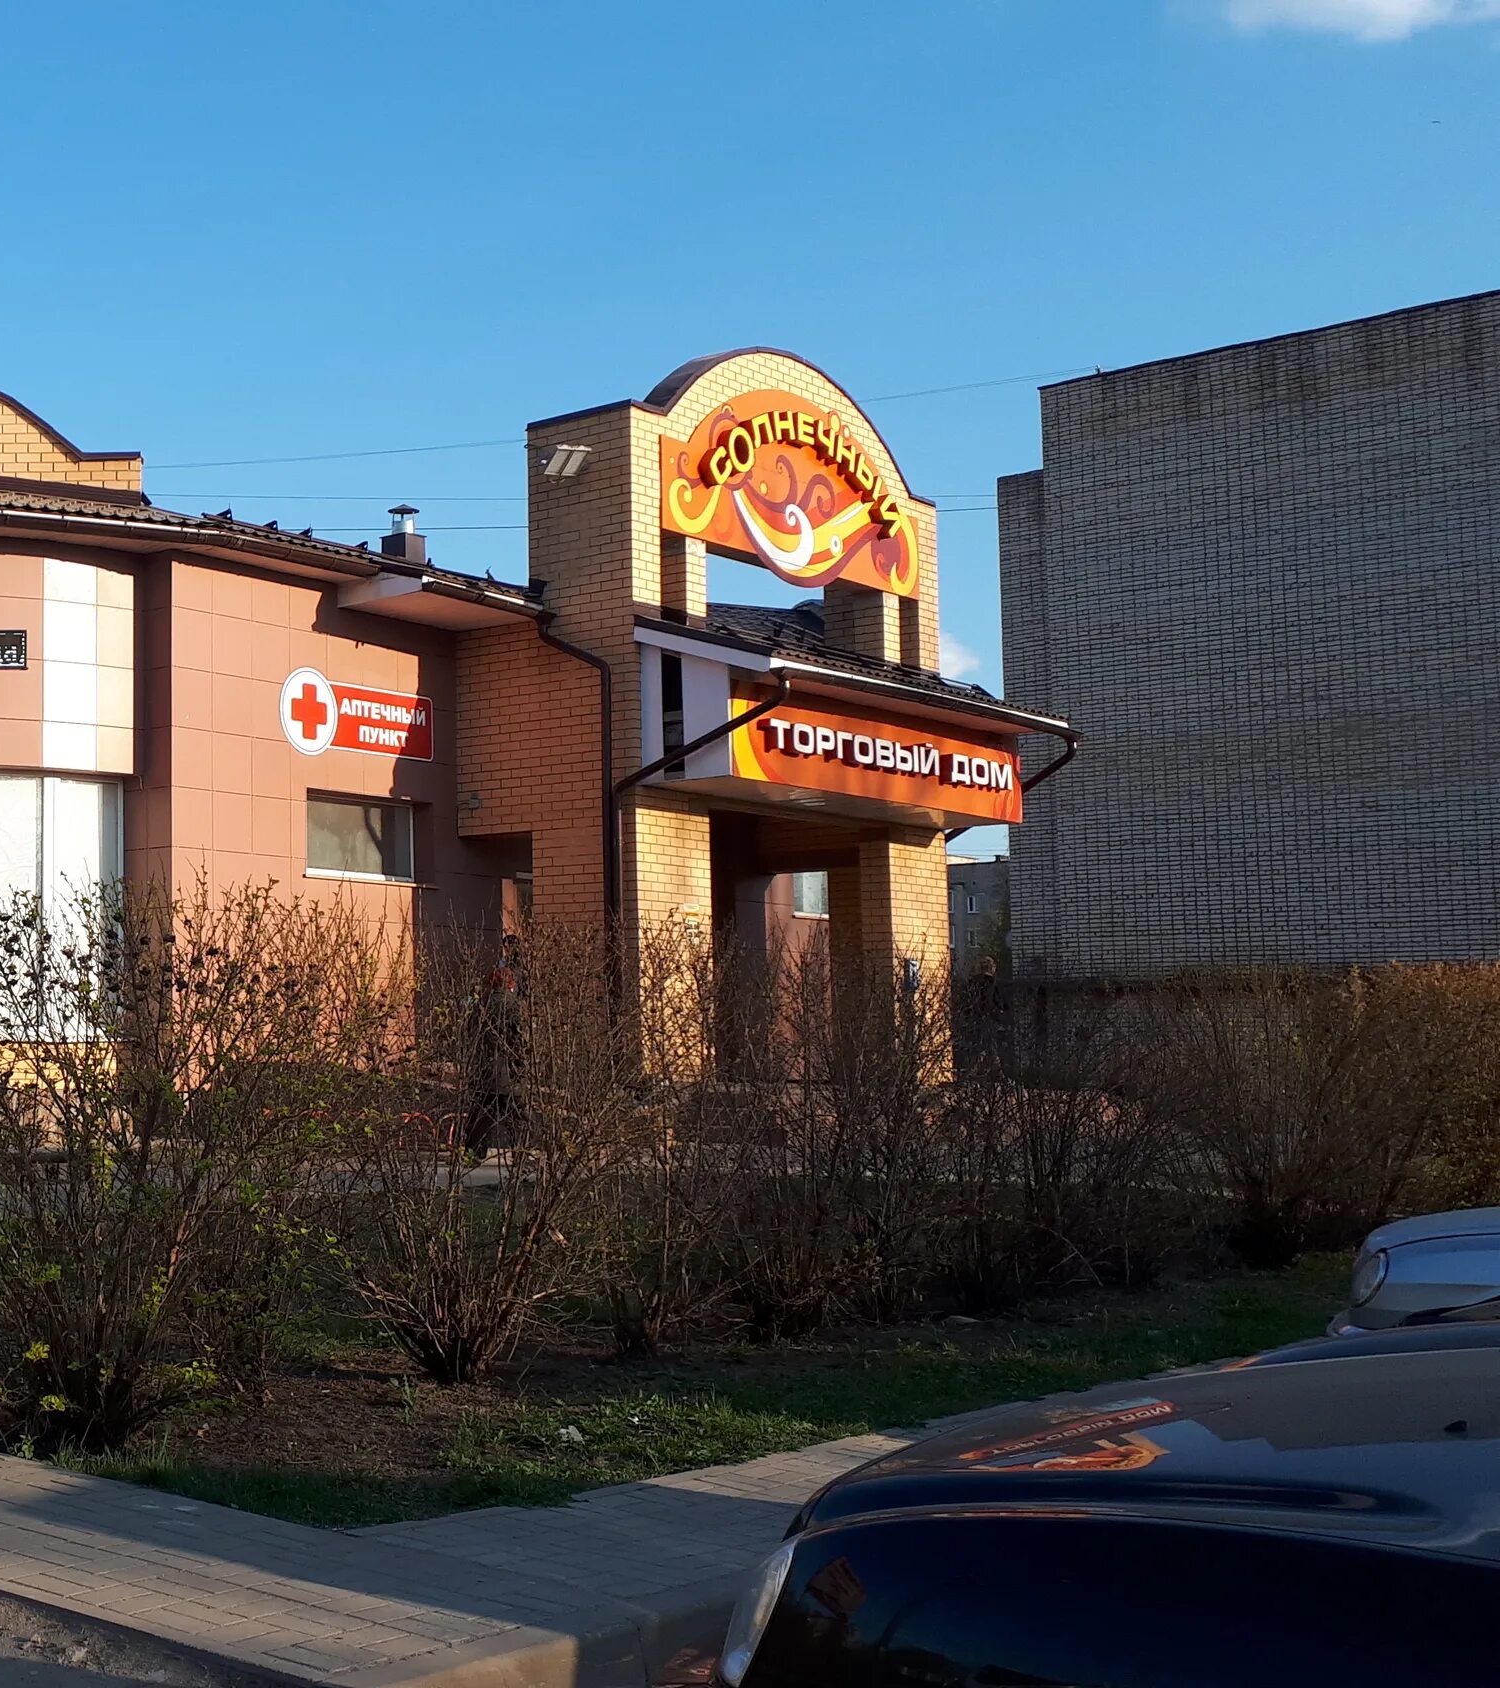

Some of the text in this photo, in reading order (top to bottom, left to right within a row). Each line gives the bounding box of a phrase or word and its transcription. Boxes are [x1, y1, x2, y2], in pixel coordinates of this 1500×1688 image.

[709, 410, 903, 538] СОЛНЕЧНЫЙ
[340, 697, 427, 727] АПТЕЧНЫЙ
[358, 725, 410, 748] ПУНКТ
[769, 718, 1014, 791] ТОРГОВЫЙ ДОМ
